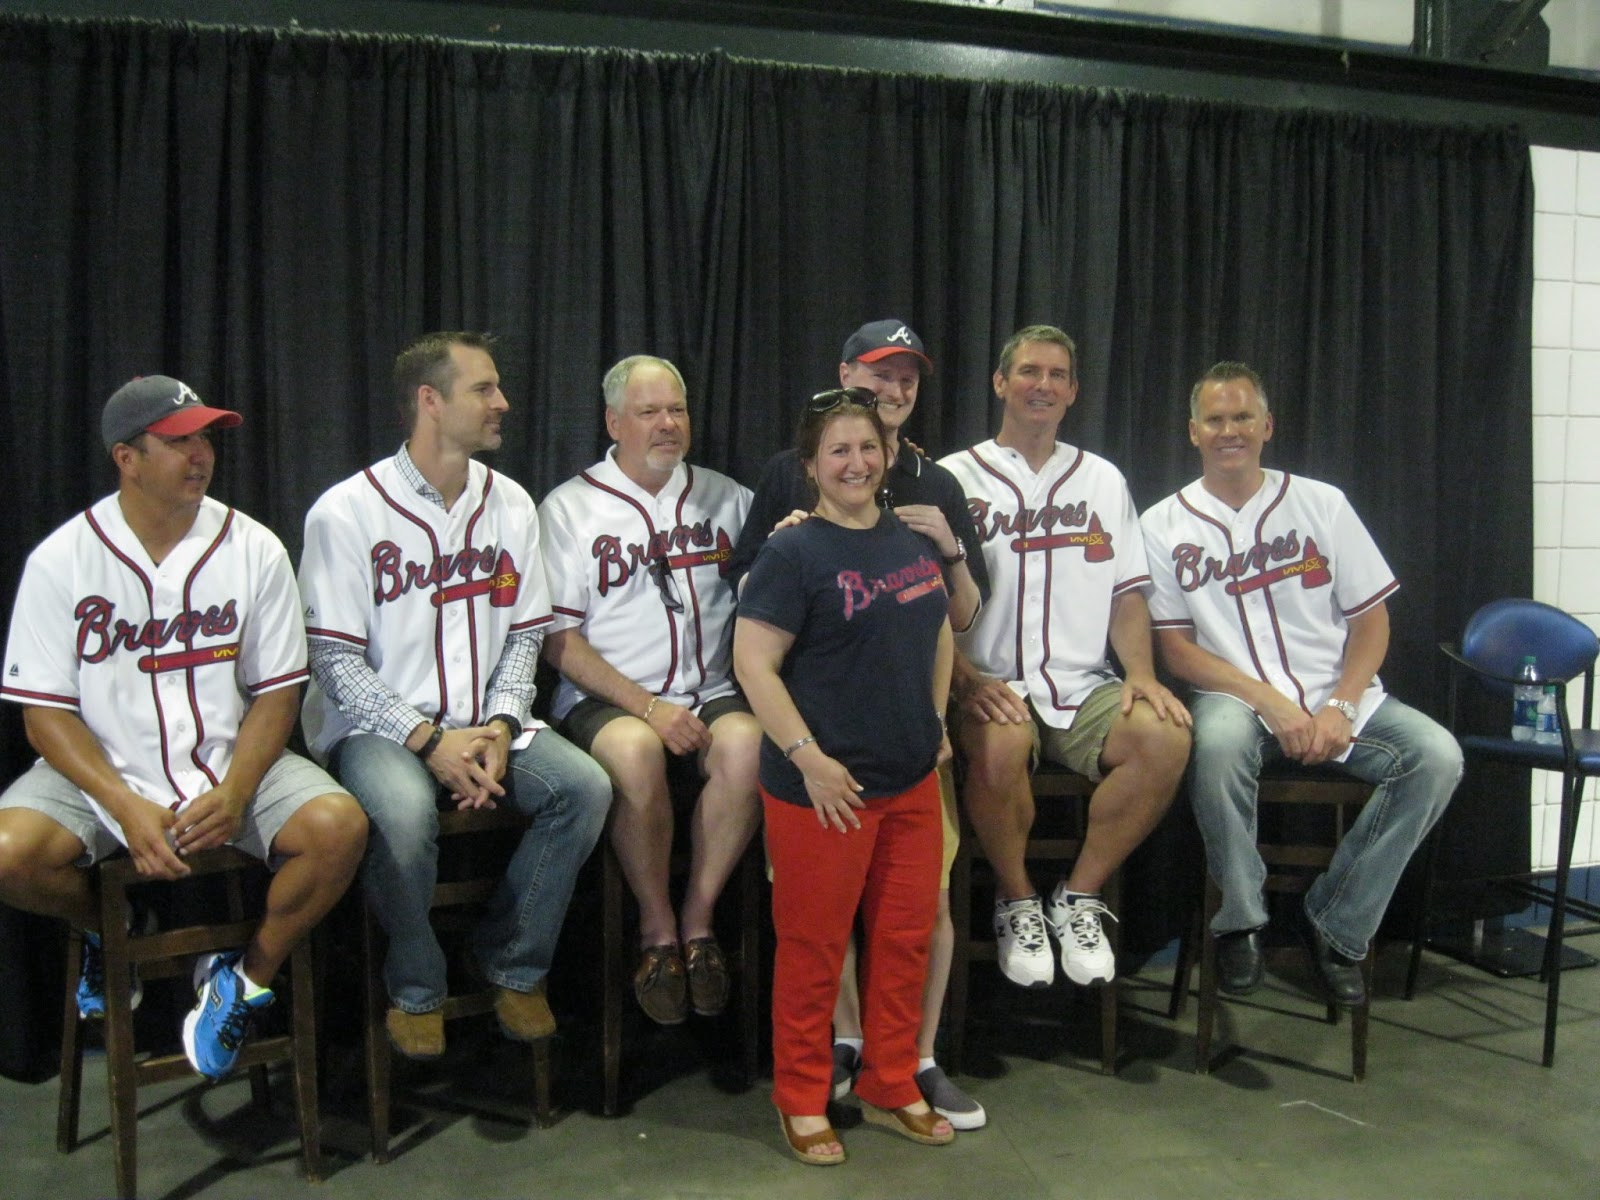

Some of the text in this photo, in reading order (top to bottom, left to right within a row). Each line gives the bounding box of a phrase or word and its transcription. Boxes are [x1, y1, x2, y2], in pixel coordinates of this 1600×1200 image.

[887, 326, 911, 345] A
[173, 381, 198, 405] A
[371, 540, 499, 606] Brave
[592, 518, 714, 597] Braves
[1172, 529, 1300, 592] Braves
[75, 595, 238, 666] Braves
